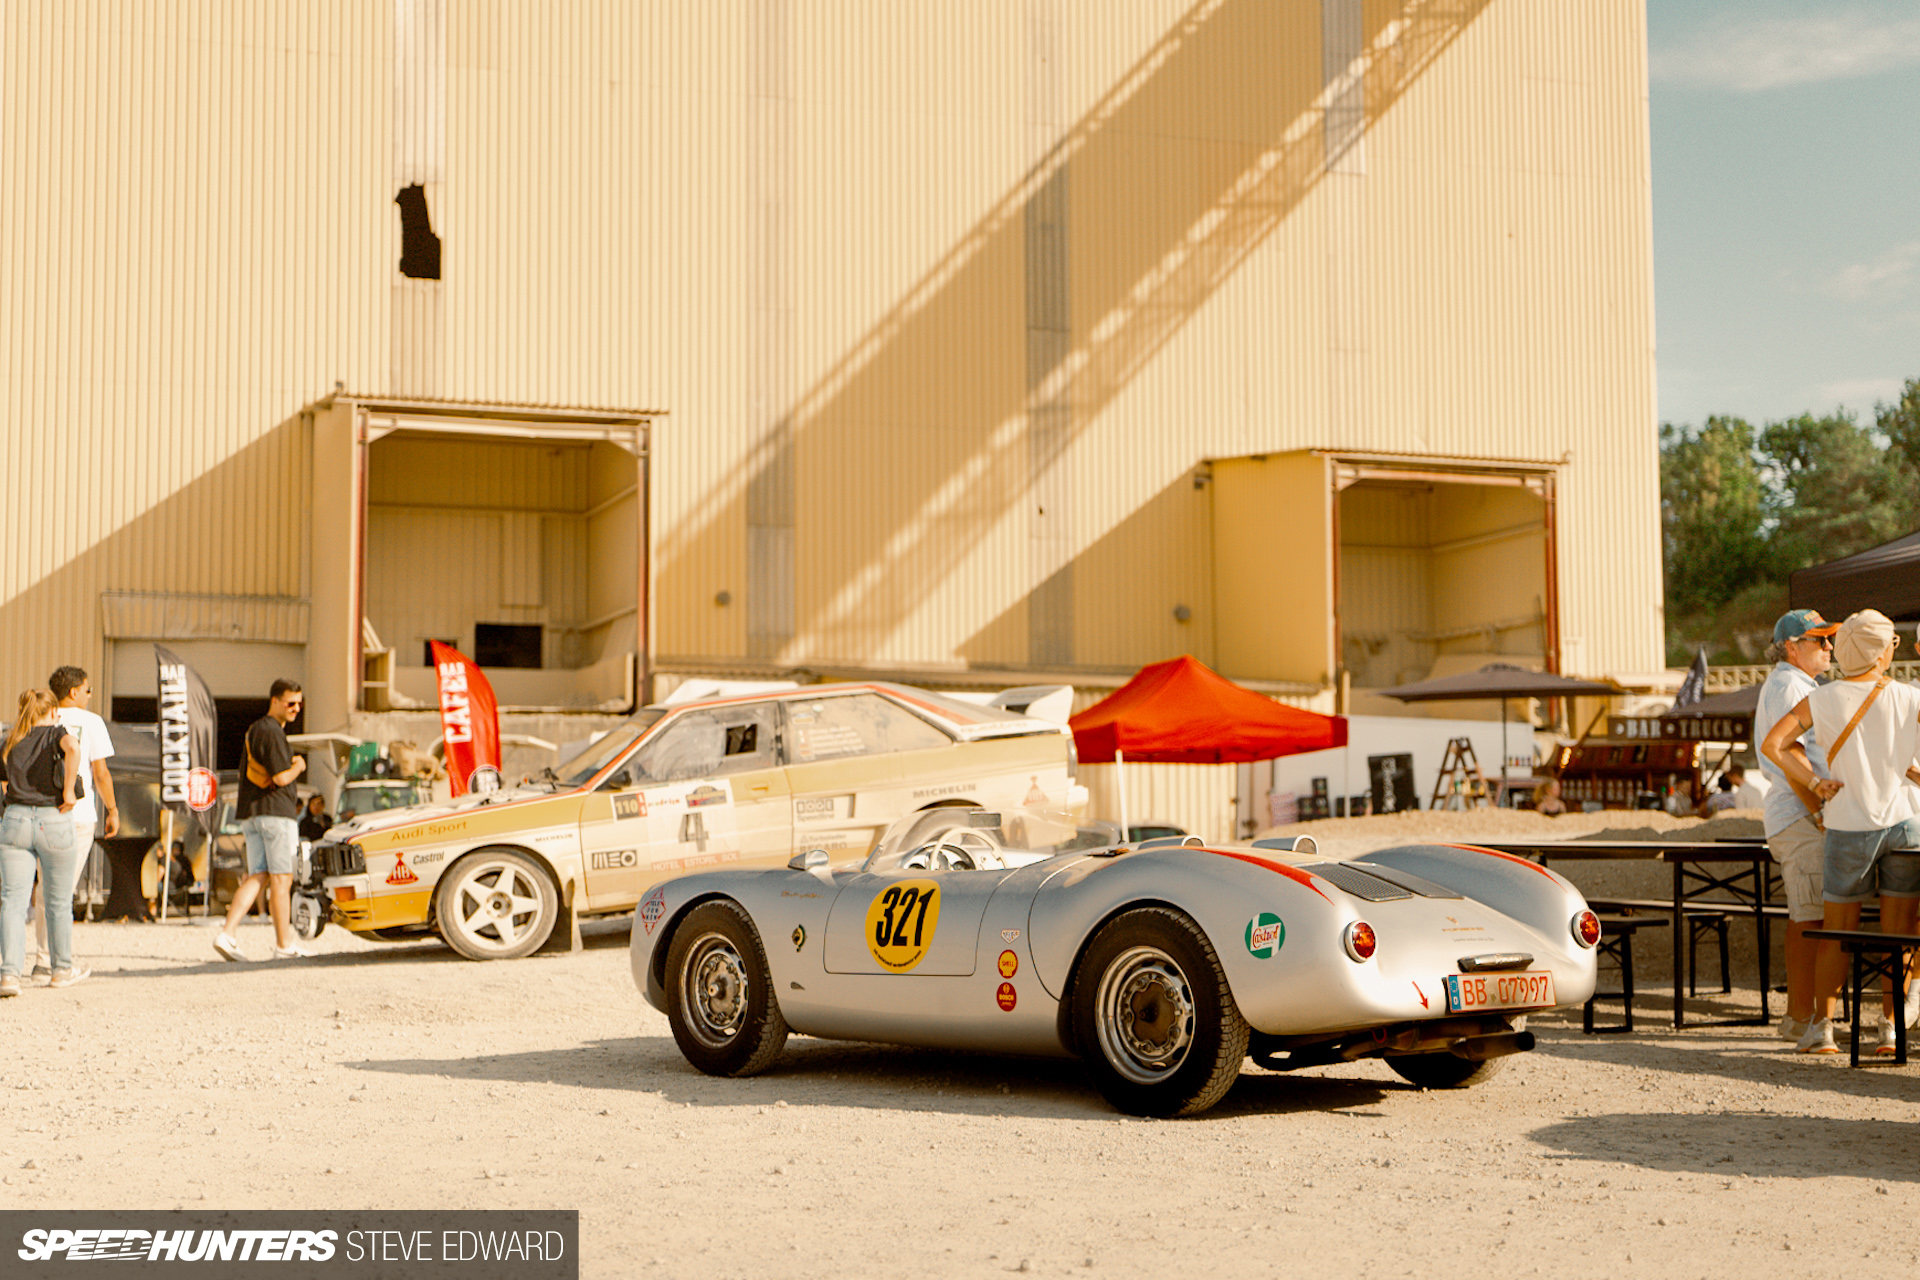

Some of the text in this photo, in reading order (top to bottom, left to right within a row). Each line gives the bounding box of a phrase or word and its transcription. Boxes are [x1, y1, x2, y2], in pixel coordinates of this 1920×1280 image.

[1626, 718, 1733, 739] BAR TRUCK
[161, 679, 189, 802] COCKTAIL
[912, 783, 977, 799] MICHELIN
[614, 799, 639, 816] 110
[390, 821, 468, 843] Audi Sport
[678, 812, 709, 852] 4
[412, 851, 445, 865] Castrol
[653, 851, 739, 872] HOTEL ESTORIL SOL
[876, 887, 936, 947] 321
[1462, 976, 1548, 1006] BB 07997
